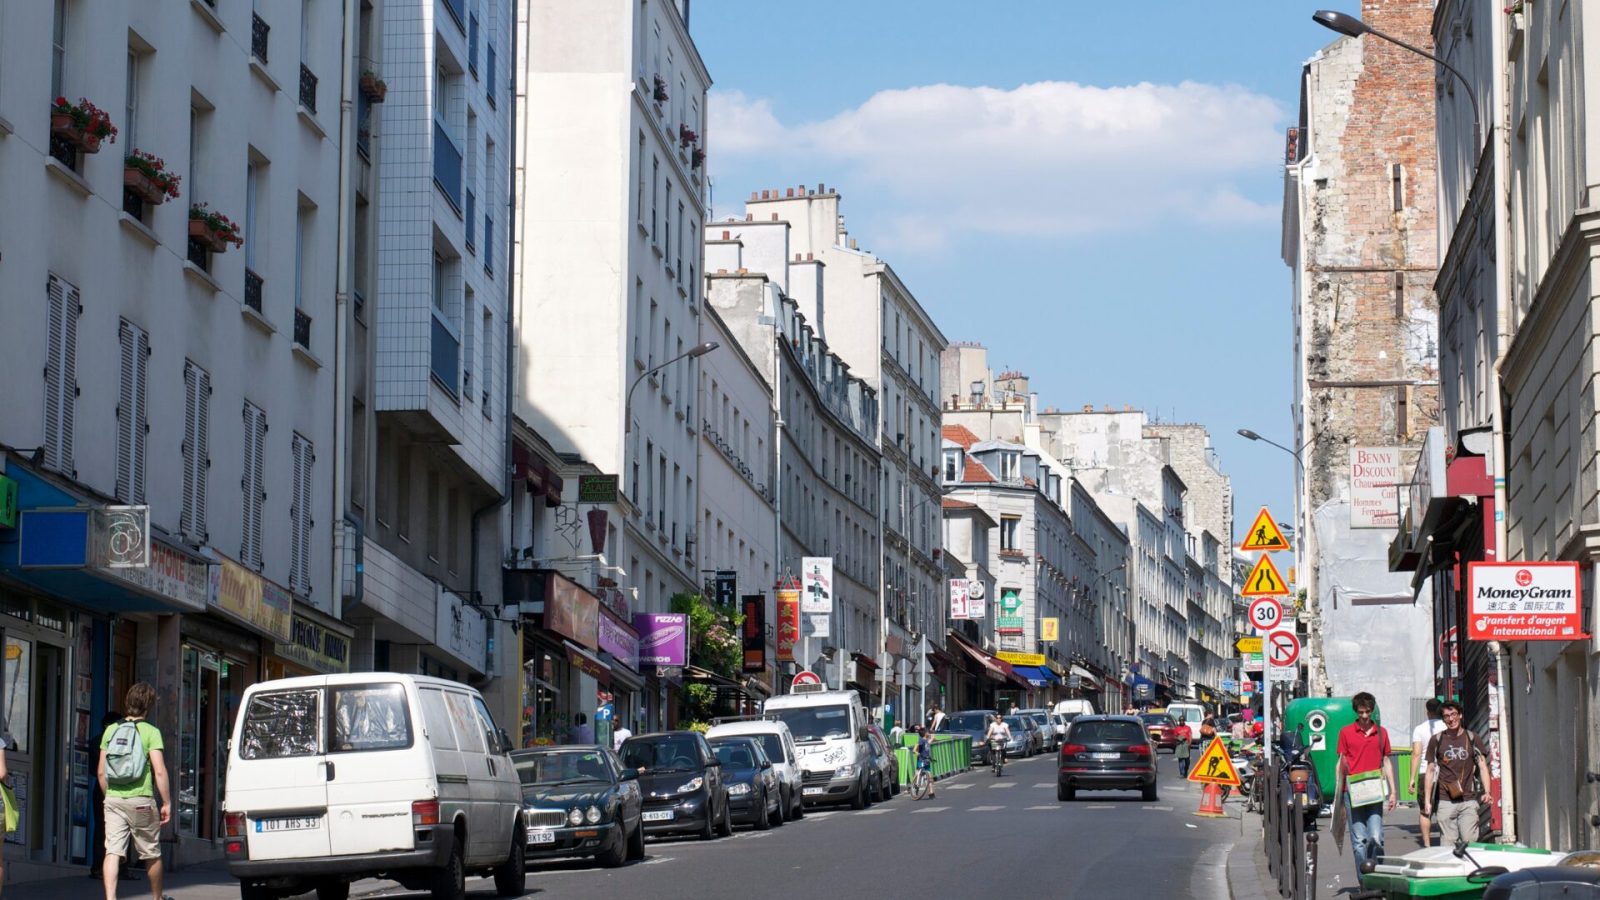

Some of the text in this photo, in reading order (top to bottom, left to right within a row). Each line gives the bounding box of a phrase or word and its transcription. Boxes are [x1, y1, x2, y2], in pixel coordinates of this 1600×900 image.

[1358, 450, 1391, 463] BENNY
[1353, 464, 1396, 477] DISCOUNT
[1353, 498, 1382, 506] Hommes
[1372, 517, 1397, 525] Enfants
[1477, 587, 1572, 601] MoneyGram
[1487, 601, 1566, 611] 速汇金 国际汇款
[1257, 607, 1275, 620] 30
[1482, 616, 1567, 627] Transfert d'argent
[1493, 627, 1557, 636] international
[603, 709, 610, 719] P
[305, 817, 316, 828] 93
[542, 832, 553, 842] 92
